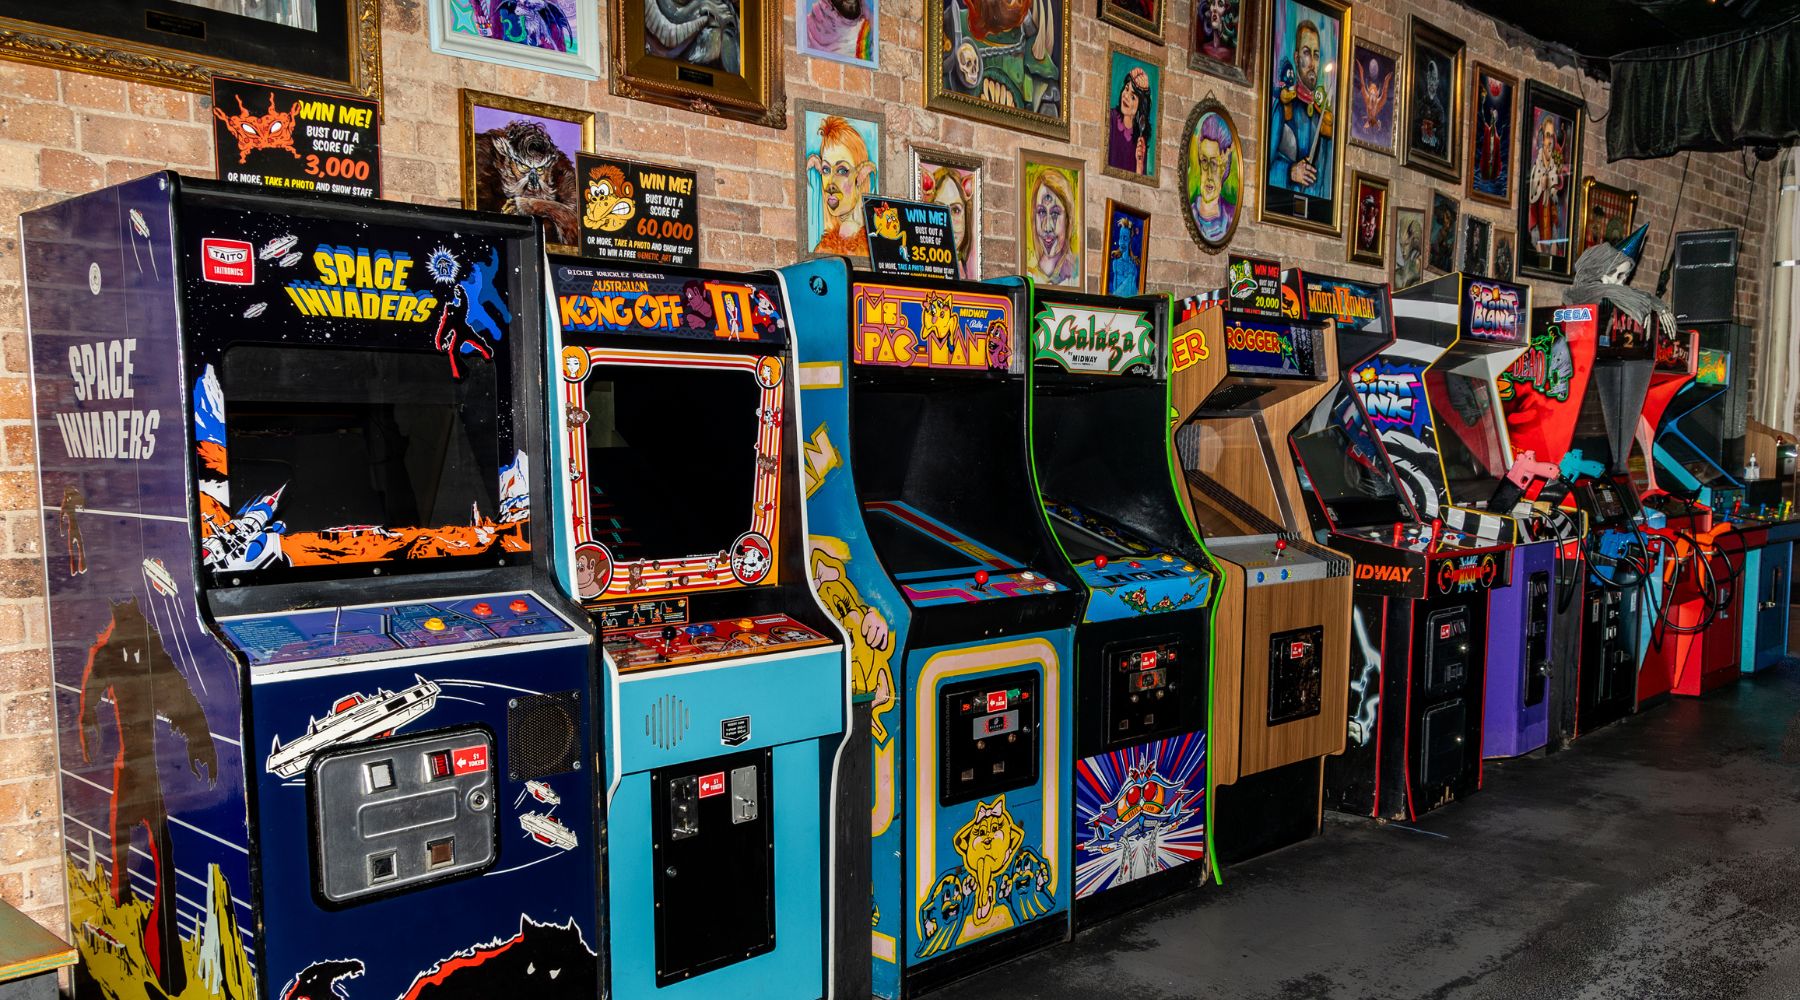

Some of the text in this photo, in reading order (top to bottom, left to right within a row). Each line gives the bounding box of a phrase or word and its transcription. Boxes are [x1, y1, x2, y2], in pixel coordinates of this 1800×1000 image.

[299, 100, 373, 128] WIN ME!
[306, 125, 360, 144] BUST OUT A
[312, 139, 355, 155] SCORE OF
[304, 153, 370, 181] 3,000
[227, 172, 373, 198] OR MORE, TAKE A PHOTO AND SHOW STAFF
[639, 172, 693, 195] WIN ME!
[645, 193, 684, 208] BUST OUT A
[650, 206, 680, 218] SCORE OF
[905, 207, 947, 227] WIN ME!
[637, 217, 694, 241] 60,000
[915, 226, 943, 237] BUST OUT A
[587, 236, 693, 255] OR MORE, TAKE A PHOTO AND SHOW STAFF
[935, 237, 942, 246] OF
[213, 250, 243, 261] TAITO
[599, 247, 606, 256] TO
[607, 248, 618, 257] WIN
[618, 249, 623, 258] A
[623, 250, 636, 259] FREE
[672, 255, 684, 264] PIN!
[911, 245, 952, 264] 35,000
[312, 244, 415, 291] SPACE
[567, 269, 594, 277] RICHIE
[633, 272, 665, 280] PRESENTS
[1254, 264, 1280, 278] WIN ME!
[591, 279, 649, 293] AUSTRALIAN
[284, 281, 439, 323] INVADERS
[1255, 295, 1280, 309] 20,000
[1308, 290, 1342, 314] MORTA
[1480, 286, 1519, 310] POINT
[559, 294, 634, 329] KONG
[634, 294, 684, 329] OFF
[960, 308, 988, 318] MIDWAY
[1472, 301, 1517, 334] BLANK
[1553, 307, 1592, 322] SEGA
[1053, 314, 1136, 371] Galaga
[1226, 327, 1280, 353] ROGGER
[1623, 332, 1634, 348] 2
[1072, 355, 1098, 363] MIDWAY
[68, 338, 136, 401] SPACE
[1352, 374, 1417, 397] OINT
[56, 409, 160, 460] INVADERS
[1355, 564, 1413, 583] IDWAY
